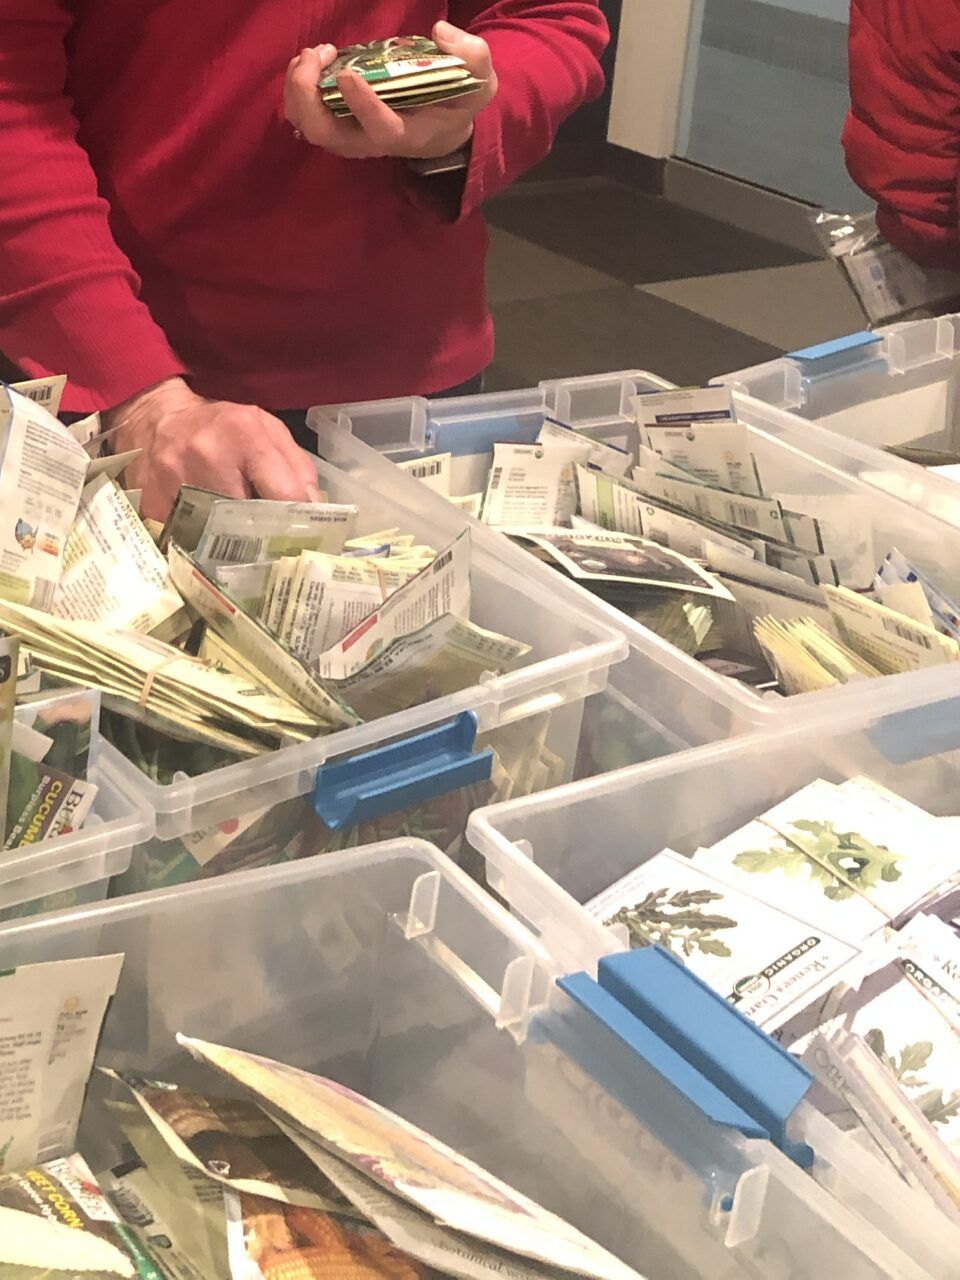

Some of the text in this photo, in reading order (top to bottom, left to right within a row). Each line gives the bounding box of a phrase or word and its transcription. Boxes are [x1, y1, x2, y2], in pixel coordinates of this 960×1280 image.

[18, 774, 51, 823] Burpless
[764, 937, 817, 977] ORGANIC
[47, 1193, 85, 1229] CORN
